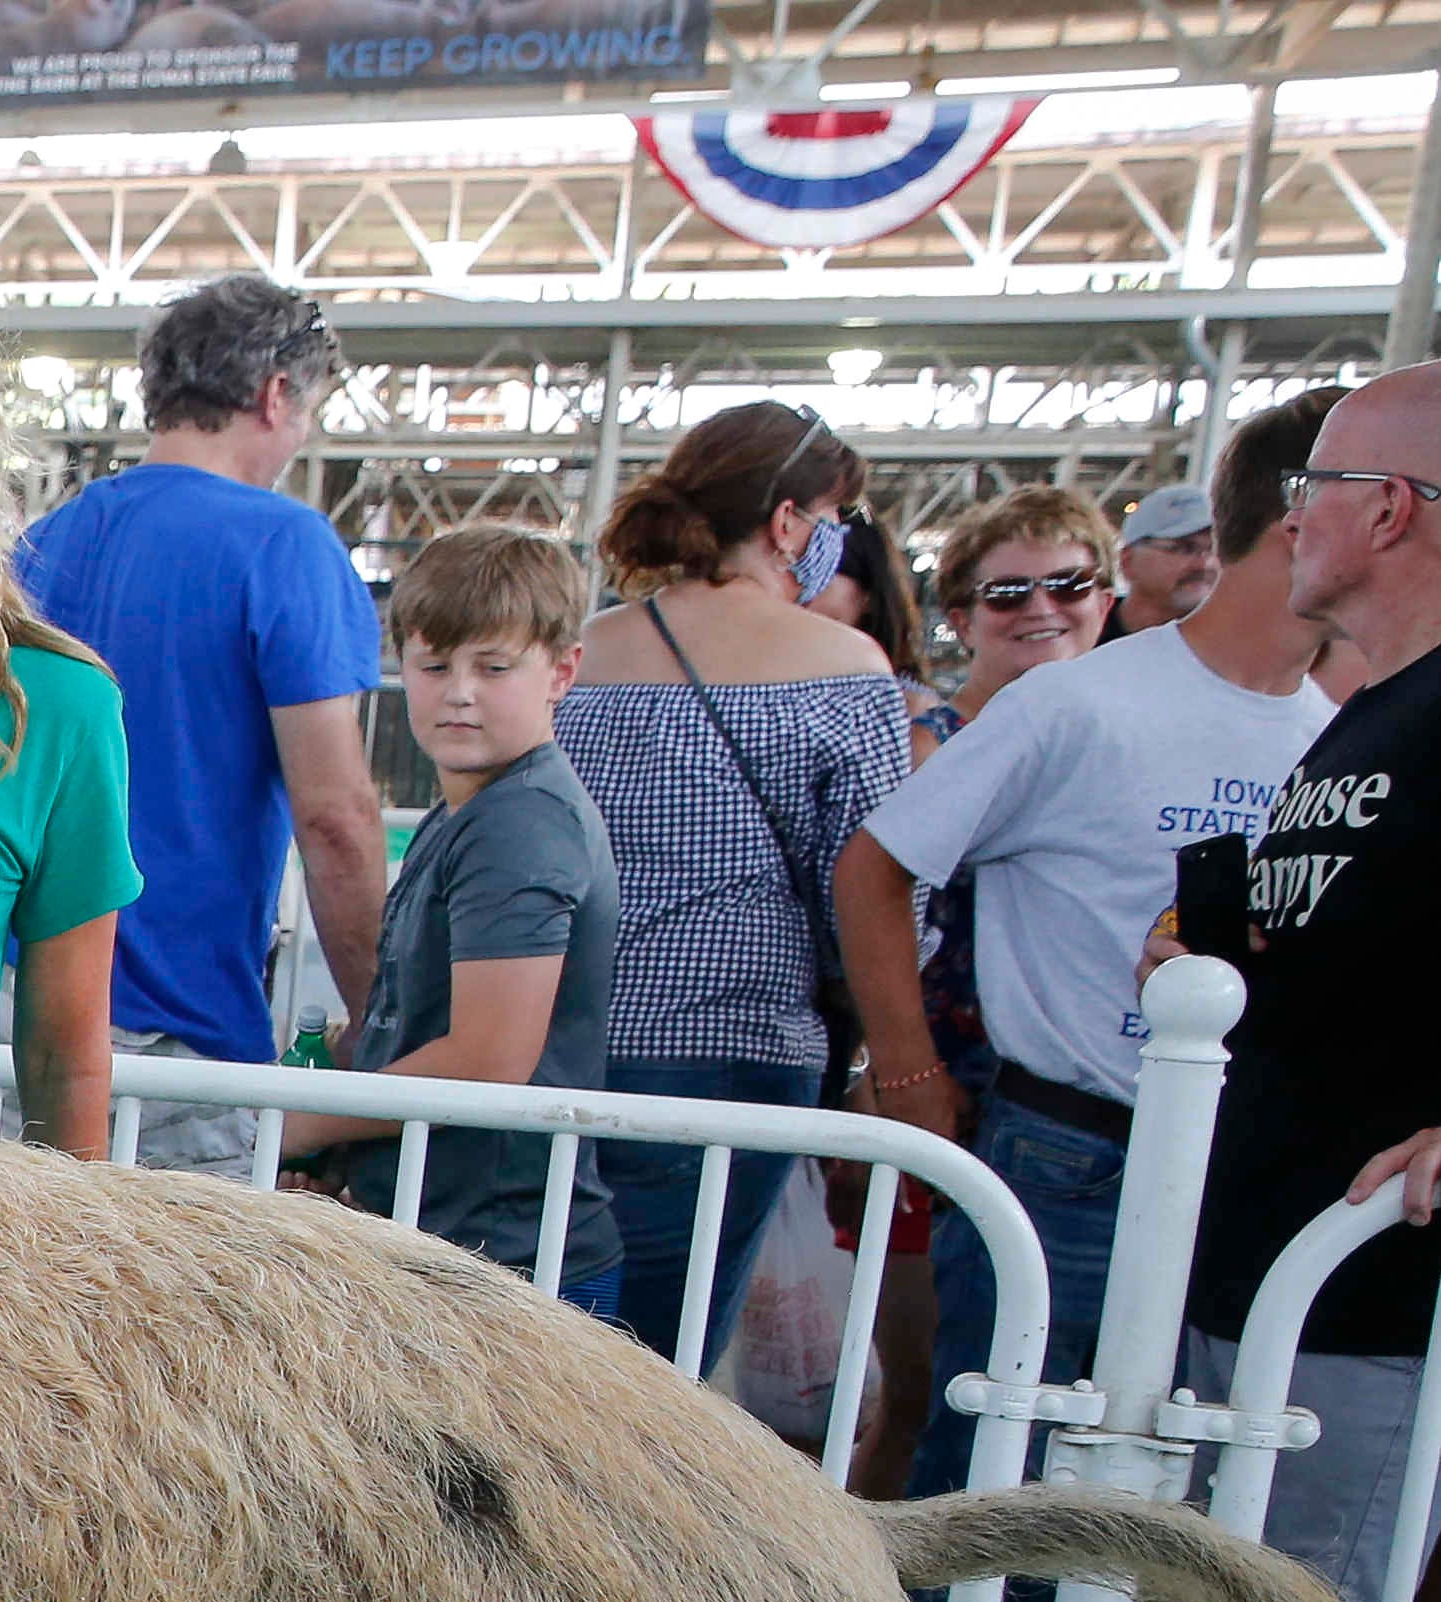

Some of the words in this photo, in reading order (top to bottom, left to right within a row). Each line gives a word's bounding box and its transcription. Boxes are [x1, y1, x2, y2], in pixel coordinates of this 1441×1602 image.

[326, 36, 434, 79] KEEP
[1212, 777, 1276, 808] IOW
[1157, 806, 1258, 839] STATE
[1247, 854, 1353, 929] appy
